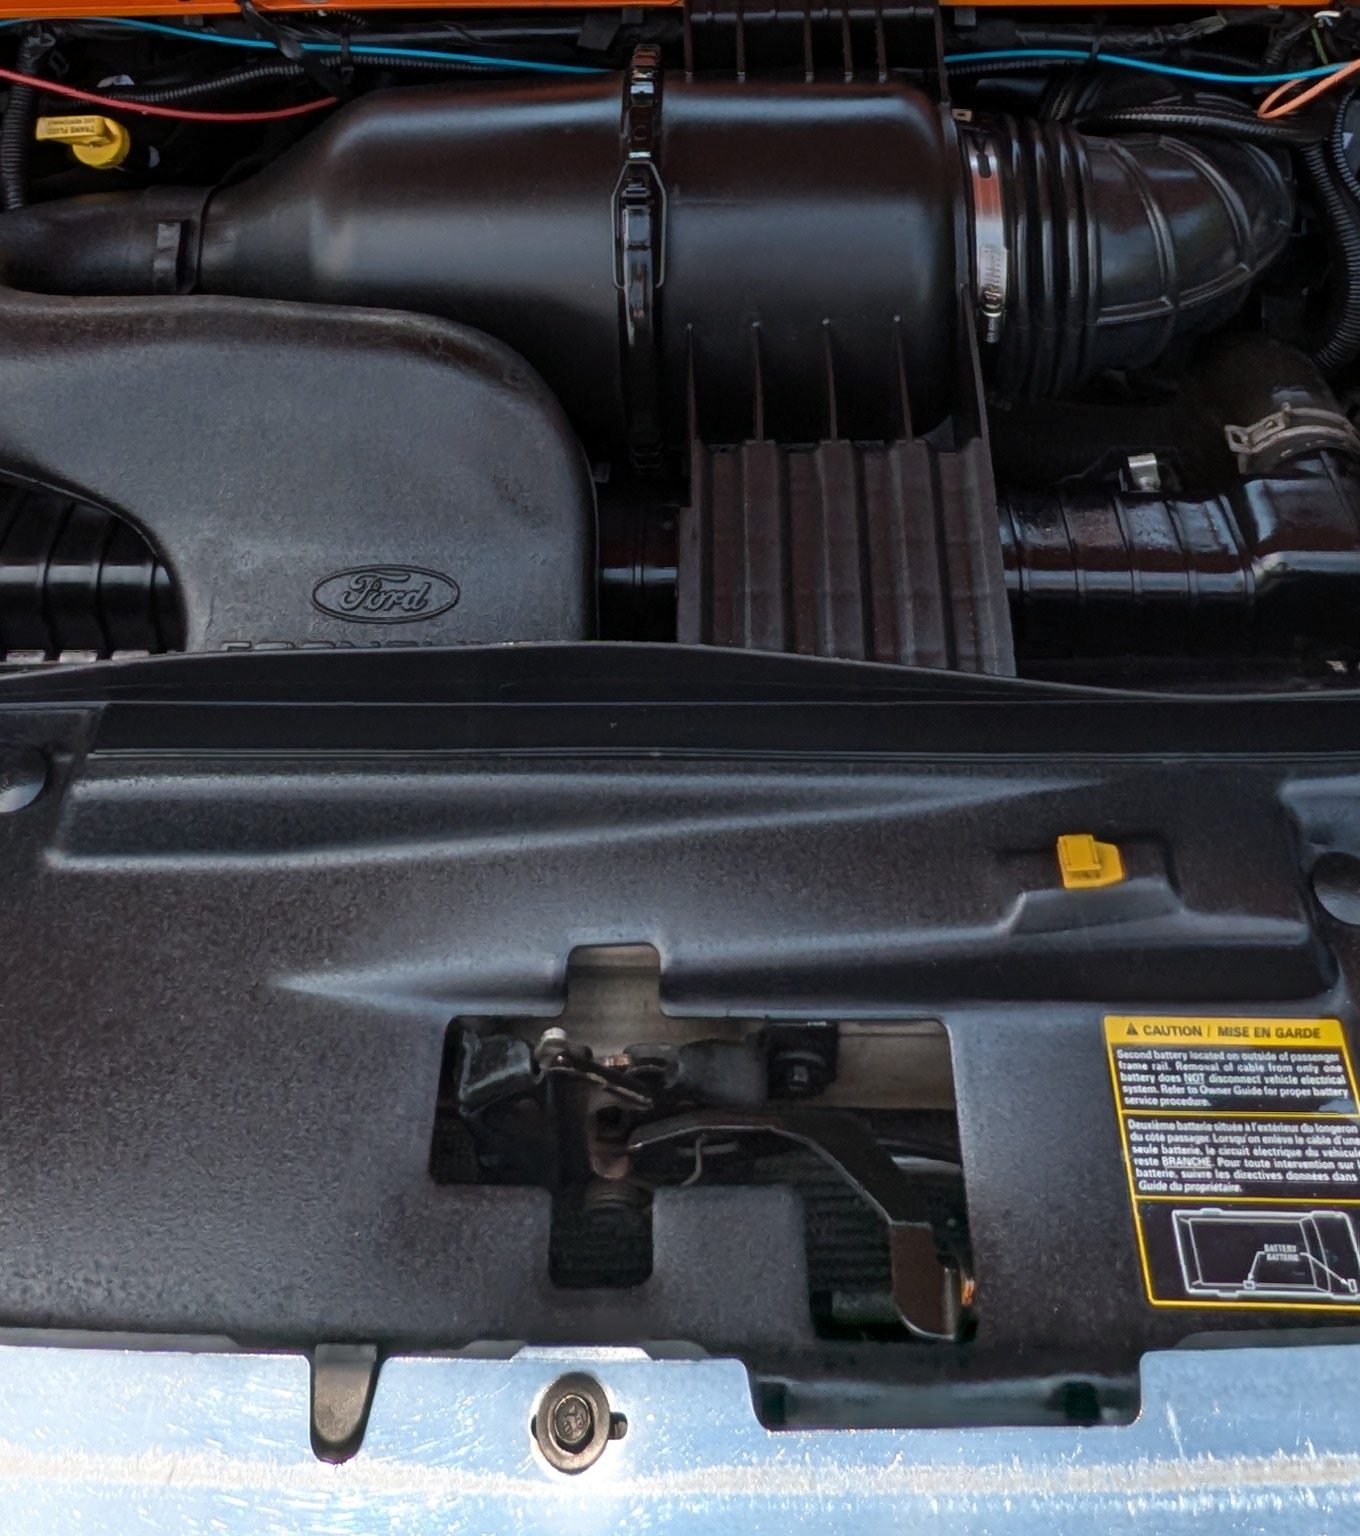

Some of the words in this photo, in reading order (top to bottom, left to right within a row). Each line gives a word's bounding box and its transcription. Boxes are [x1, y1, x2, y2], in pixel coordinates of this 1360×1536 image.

[339, 571, 432, 613] Ford
[1142, 1024, 1203, 1036] CAUTION
[1216, 1026, 1250, 1037] MISE
[1252, 1026, 1272, 1038] EN
[1273, 1027, 1322, 1039] GARDE
[1115, 1048, 1153, 1059] Second
[1152, 1049, 1189, 1061] battery
[1188, 1050, 1225, 1060] located
[1225, 1052, 1240, 1060] on
[1239, 1051, 1277, 1061] outside
[1277, 1051, 1289, 1061] of
[1289, 1052, 1341, 1063] passenger
[1117, 1060, 1148, 1070] frame
[1150, 1061, 1172, 1070] rail.
[1174, 1061, 1220, 1071] Removal
[1221, 1062, 1235, 1071] of
[1235, 1062, 1265, 1072] cable
[1267, 1063, 1294, 1072] from
[1294, 1063, 1320, 1073] only
[1321, 1064, 1344, 1073] one
[1119, 1072, 1156, 1083] battery
[1156, 1072, 1182, 1083] does
[1182, 1072, 1206, 1083] NOT
[1207, 1073, 1262, 1084] disconnect
[1262, 1073, 1299, 1084] vehicle
[1298, 1073, 1346, 1085] electrical
[1121, 1084, 1160, 1095] system.
[1159, 1084, 1186, 1094] Refer
[1186, 1085, 1199, 1094] to
[1198, 1085, 1232, 1095] Owner
[1231, 1085, 1263, 1095] Guide
[1262, 1085, 1278, 1095] for
[1278, 1087, 1312, 1098] proper
[1311, 1086, 1350, 1099] battery
[1123, 1095, 1159, 1105] service
[1158, 1095, 1212, 1108] procedure.
[1175, 1119, 1213, 1131] batterie
[1298, 1122, 1315, 1133] du
[1313, 1122, 1359, 1135] longeron
[1128, 1131, 1144, 1141] du
[1165, 1133, 1211, 1144] passager.
[1293, 1134, 1305, 1145] le
[1130, 1143, 1159, 1154] seule
[1204, 1144, 1216, 1155] le
[1216, 1144, 1250, 1156] circuit
[1303, 1146, 1320, 1157] du
[1132, 1155, 1160, 1166] reste
[1215, 1156, 1242, 1167] Pour
[1242, 1158, 1271, 1168] toute
[1272, 1158, 1336, 1169] intervention
[1336, 1160, 1355, 1169] sur
[1180, 1169, 1213, 1179] suivre
[1214, 1168, 1231, 1179] les
[1232, 1169, 1283, 1180] directives
[1330, 1171, 1358, 1182] dans
[1137, 1179, 1168, 1191] Guide
[1168, 1180, 1183, 1191] du
[1263, 1243, 1297, 1252] BATTERY
[1265, 1253, 1300, 1261] BATTERIE
